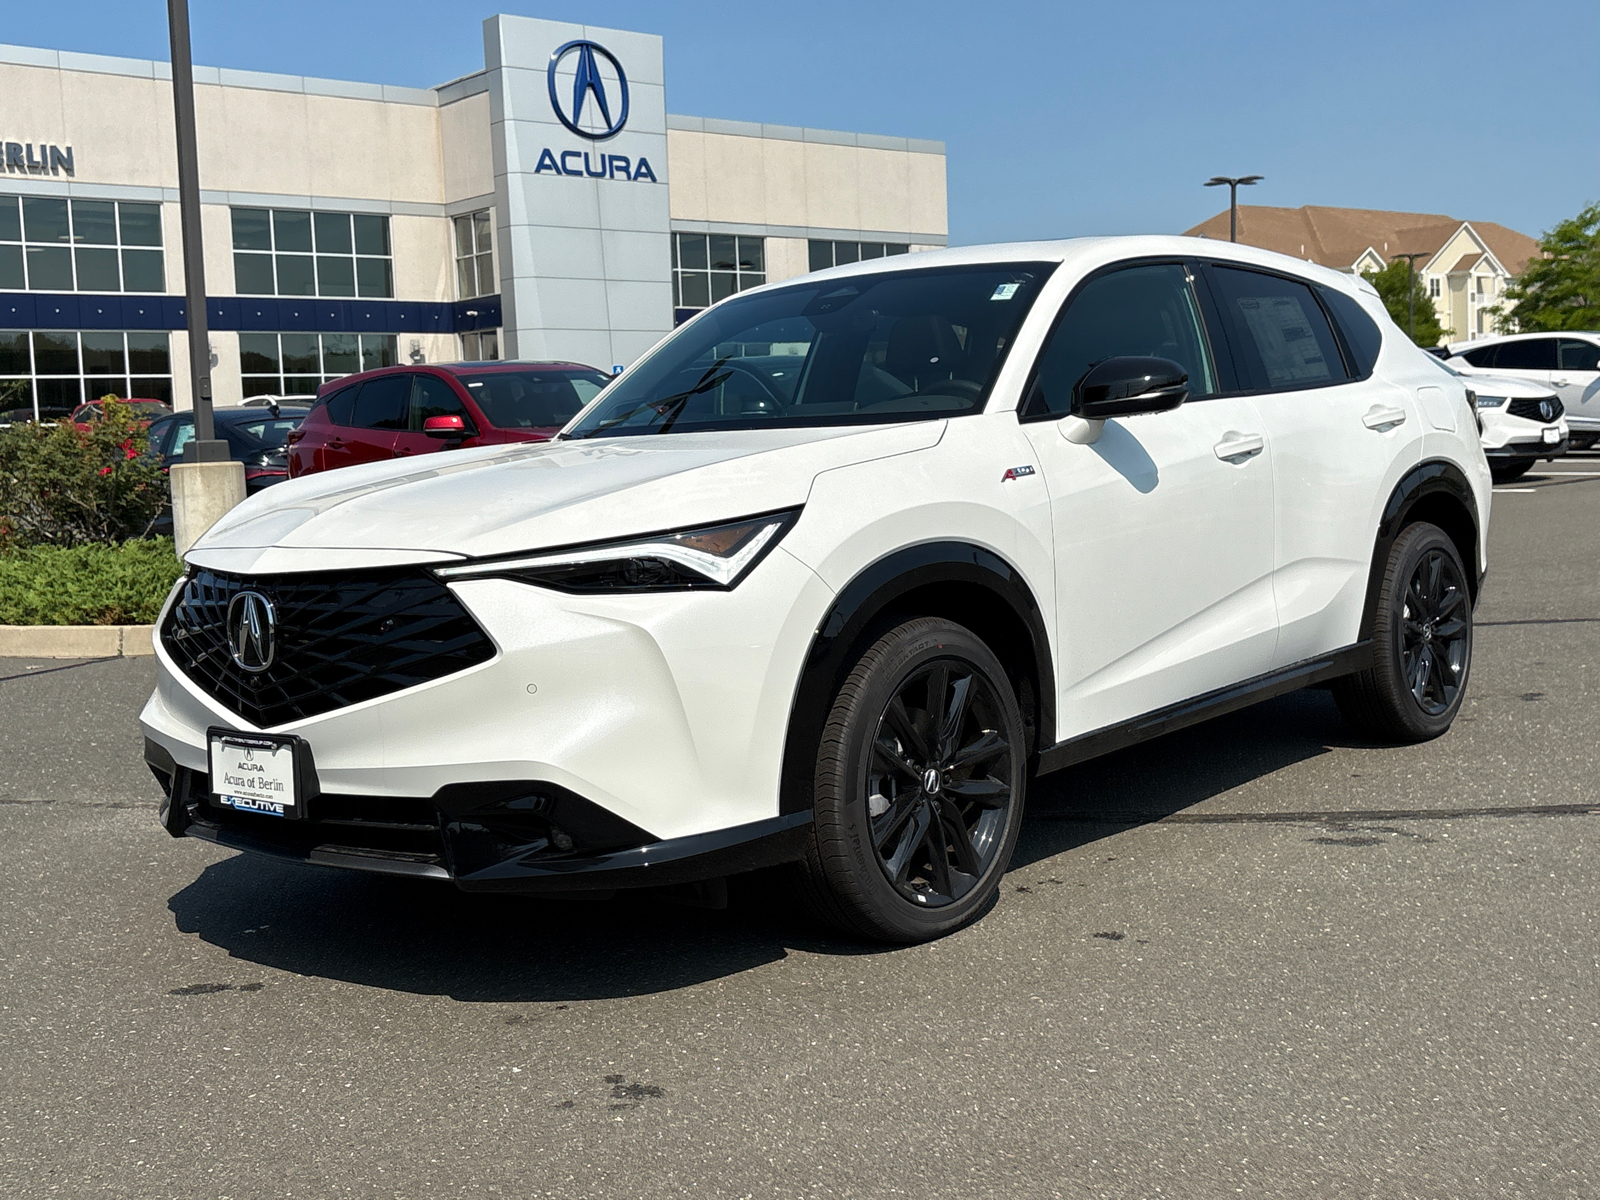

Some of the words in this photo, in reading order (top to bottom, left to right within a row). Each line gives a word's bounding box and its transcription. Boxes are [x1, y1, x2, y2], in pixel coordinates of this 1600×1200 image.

[0, 141, 75, 172] RLIN
[534, 148, 657, 183] ACURA
[237, 762, 265, 773] ACURA
[224, 771, 245, 787] Acura
[247, 777, 256, 789] of
[258, 776, 284, 792] Berlin
[220, 795, 284, 813] EXECUTIVE
